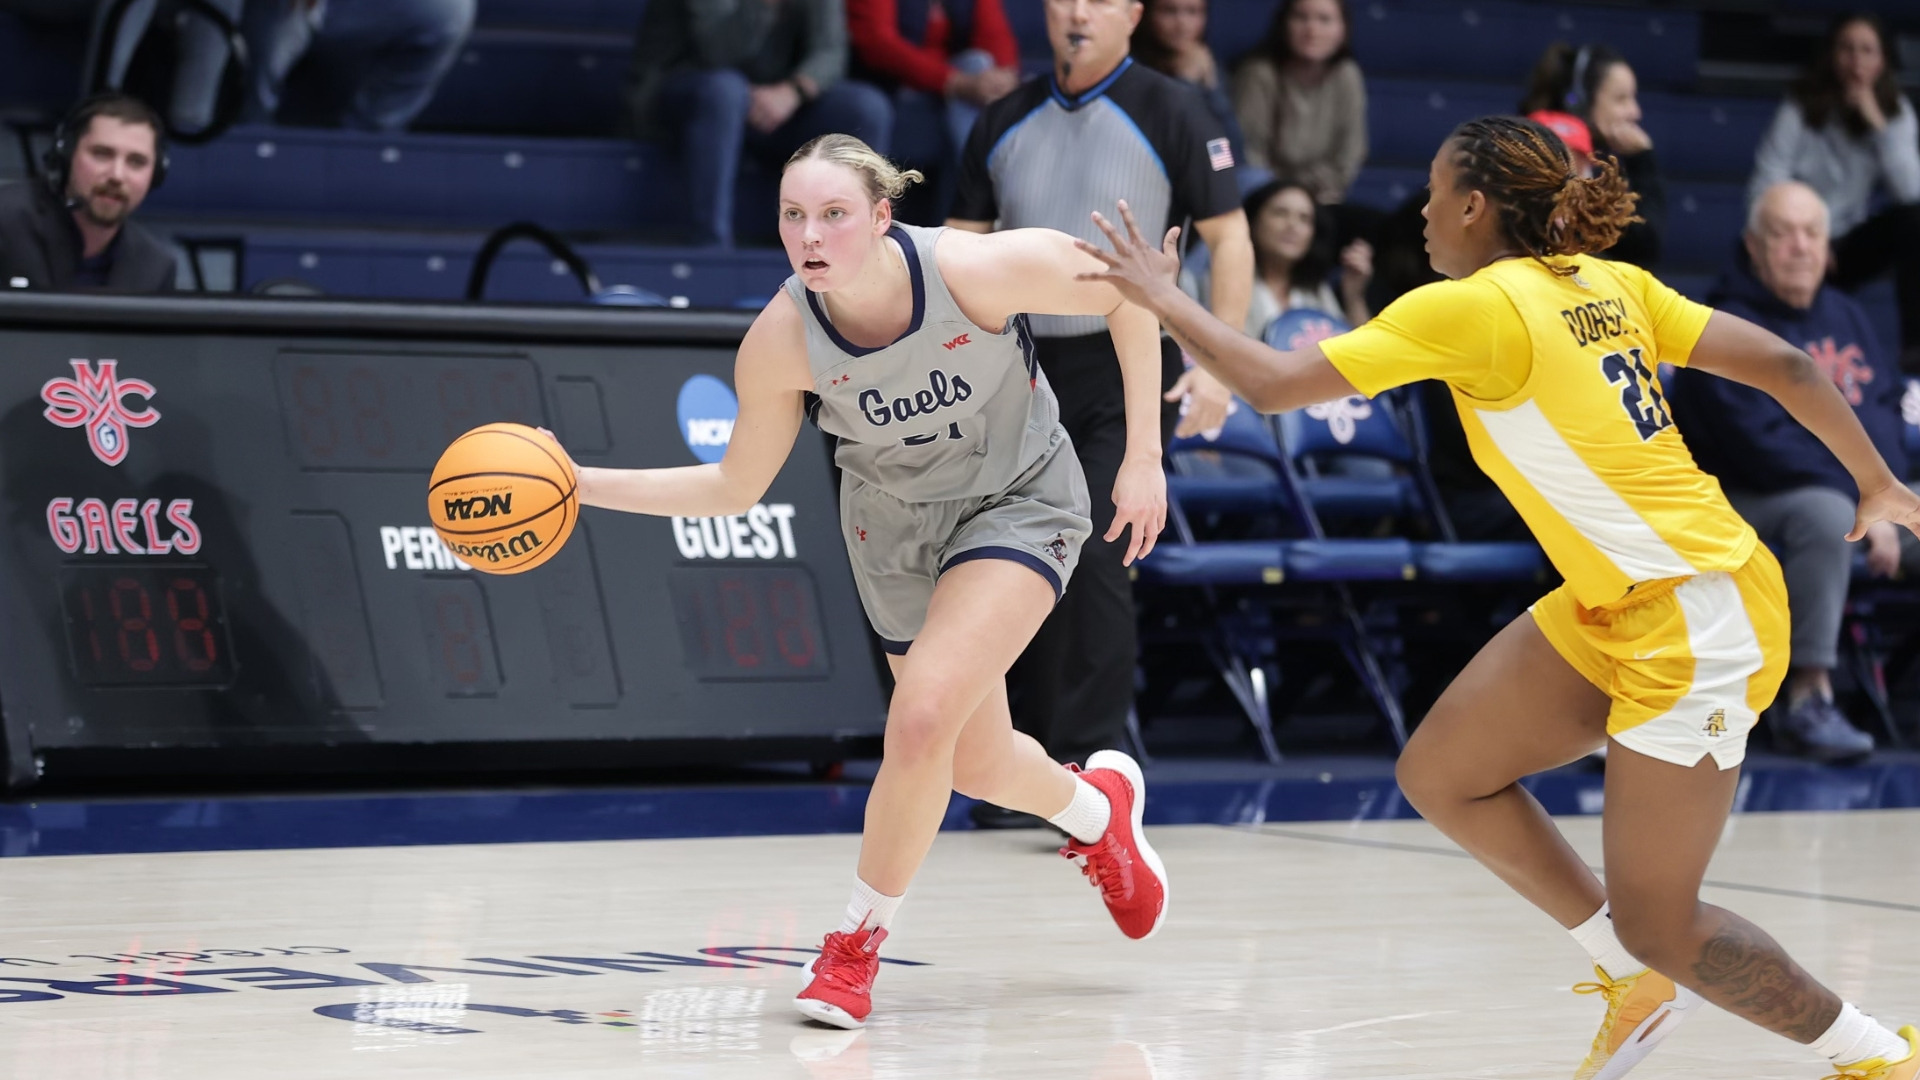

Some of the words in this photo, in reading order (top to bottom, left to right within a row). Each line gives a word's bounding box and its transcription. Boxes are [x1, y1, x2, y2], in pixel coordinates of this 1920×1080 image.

[858, 368, 972, 427] Gaels
[1600, 347, 1674, 441] 21
[46, 497, 201, 555] GAELS
[444, 493, 512, 521] NCAA
[671, 503, 797, 560] GUEST
[445, 529, 543, 563] Wilson
[69, 945, 351, 964] credit
